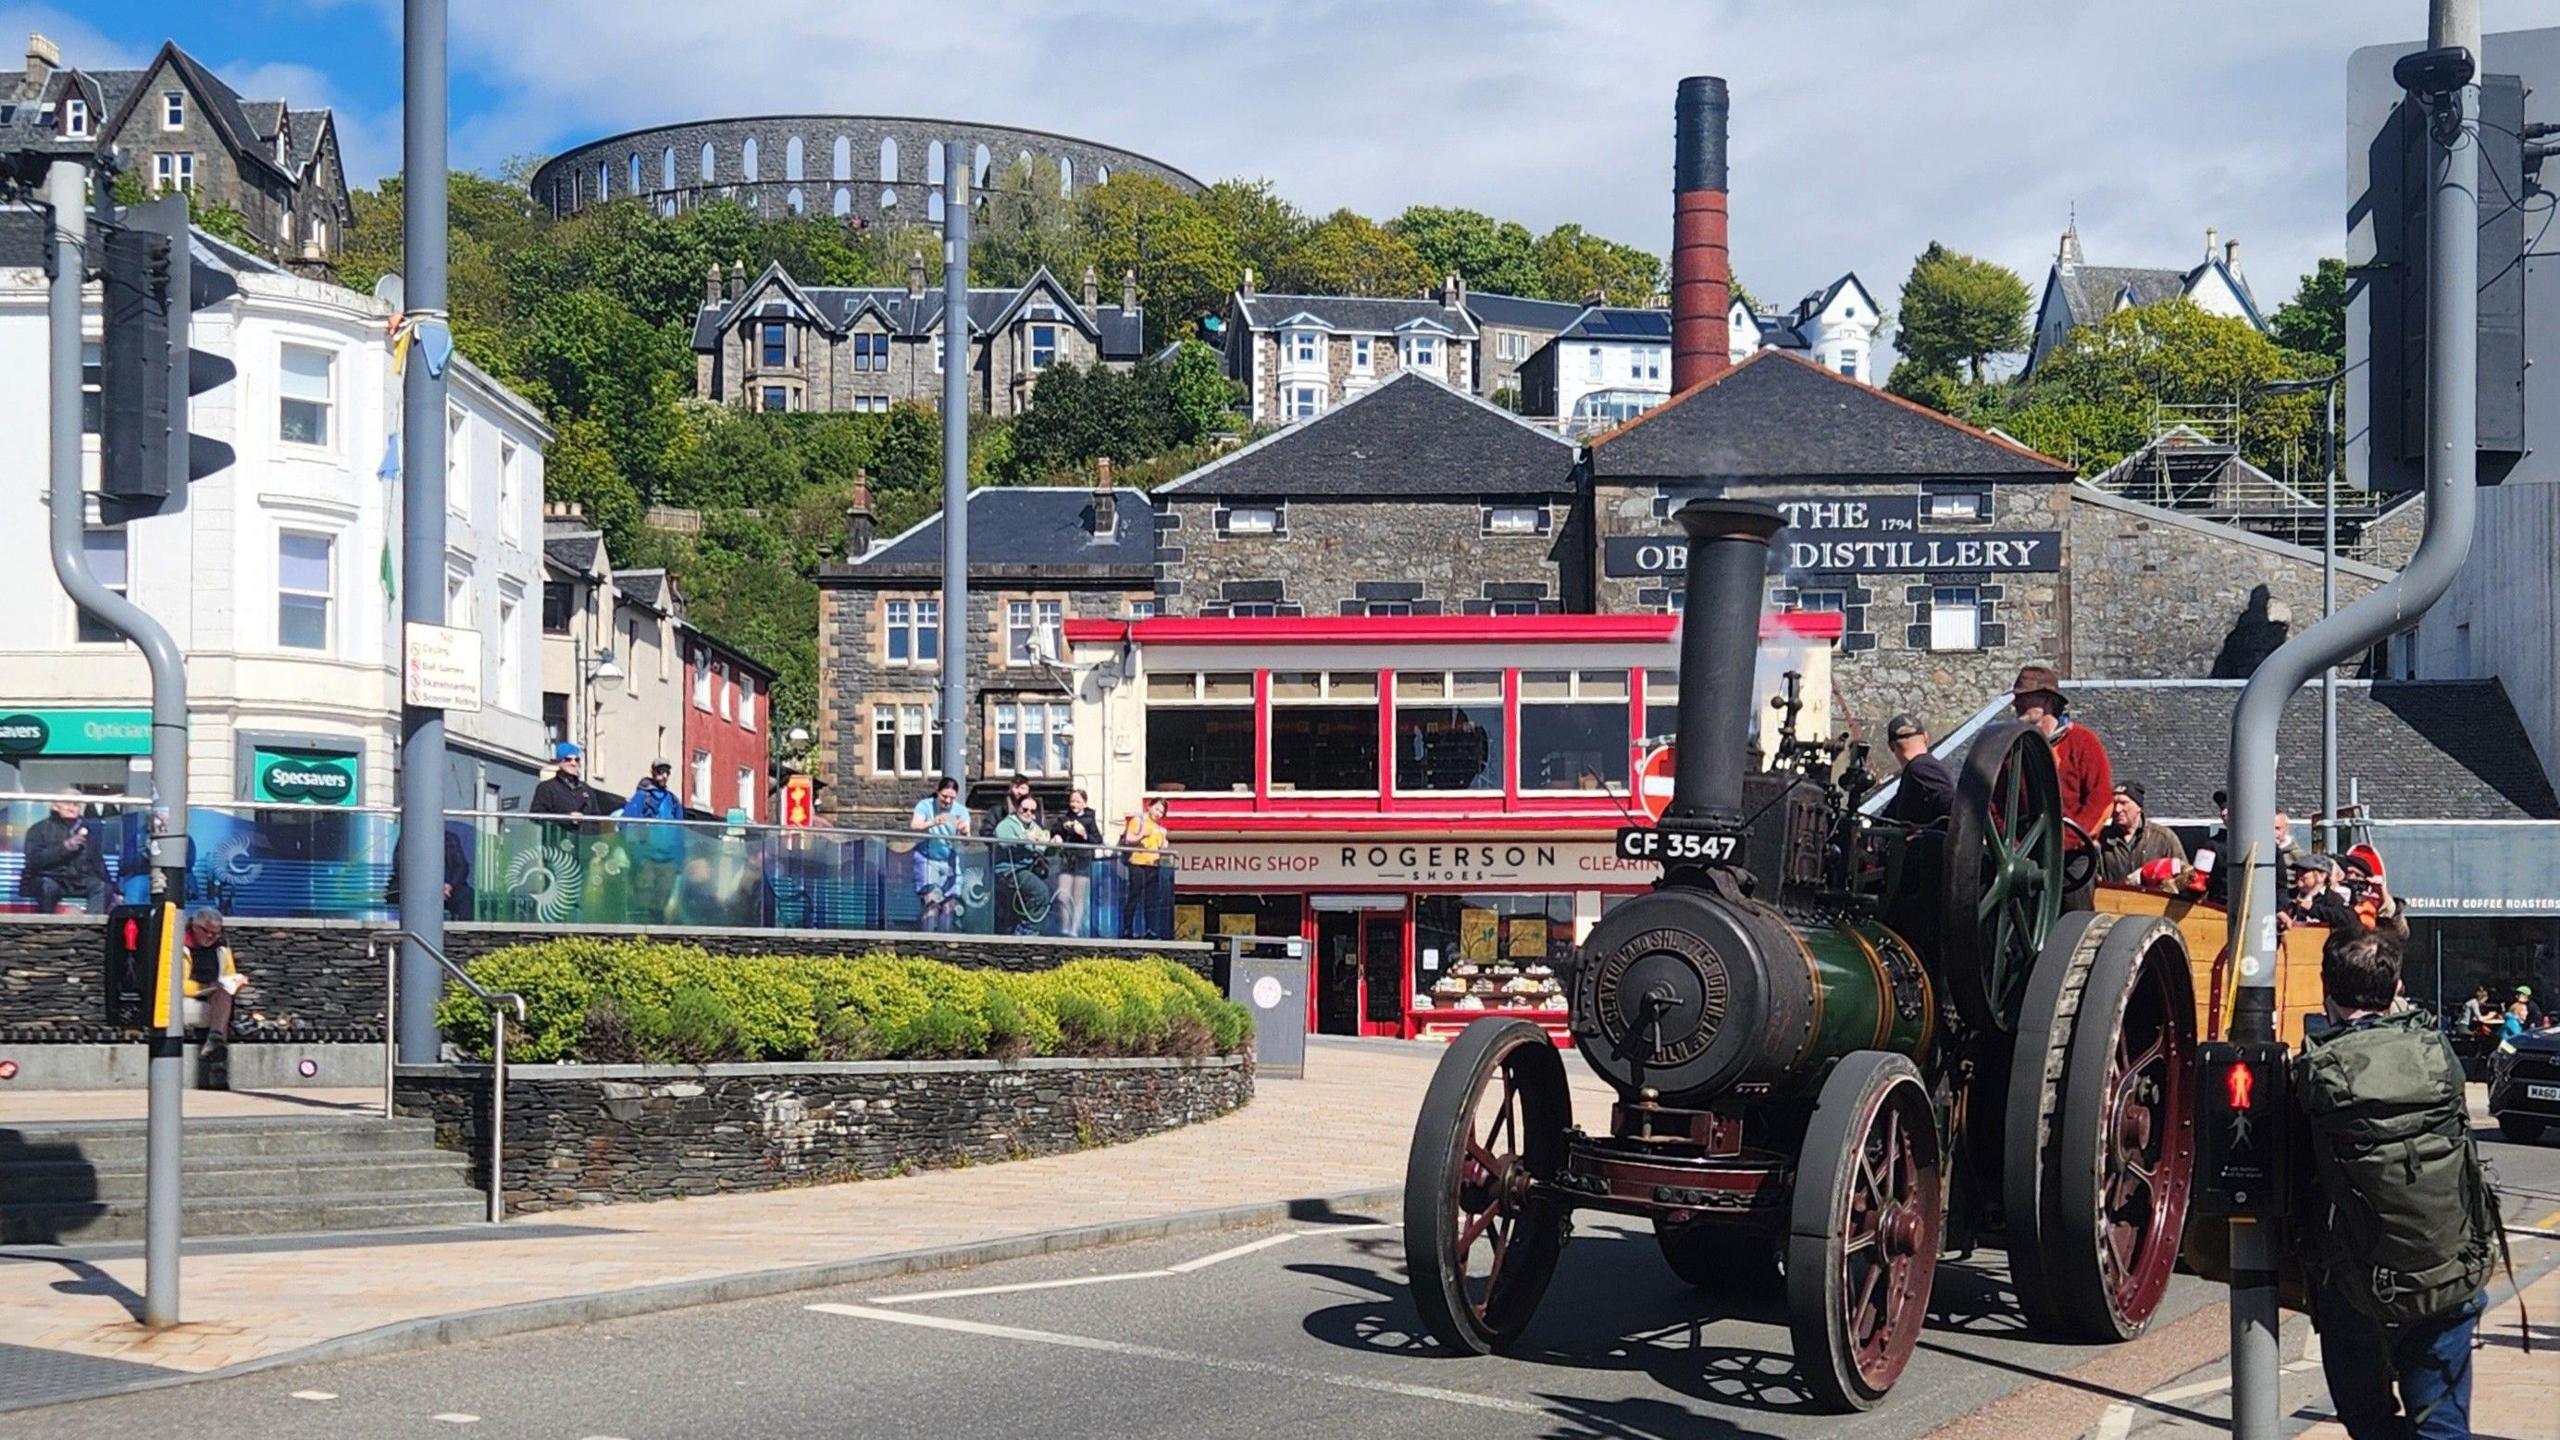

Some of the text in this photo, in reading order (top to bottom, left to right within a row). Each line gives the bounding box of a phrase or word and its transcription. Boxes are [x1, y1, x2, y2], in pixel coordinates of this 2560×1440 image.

[1777, 502, 1870, 530] THE
[1881, 519, 1913, 531] 1794
[1636, 541, 2040, 570] OB DISTILLERY
[272, 768, 346, 787] Specsavers
[1624, 833, 1736, 860] CF 3547
[1267, 856, 1319, 872] SHOP
[1341, 846, 1555, 867] ROGERSON
[1579, 855, 1660, 871] CLEARIN
[1413, 871, 1484, 881] SHOES
[2405, 897, 2560, 909] PECIALITY COFFEE ROASTERS
